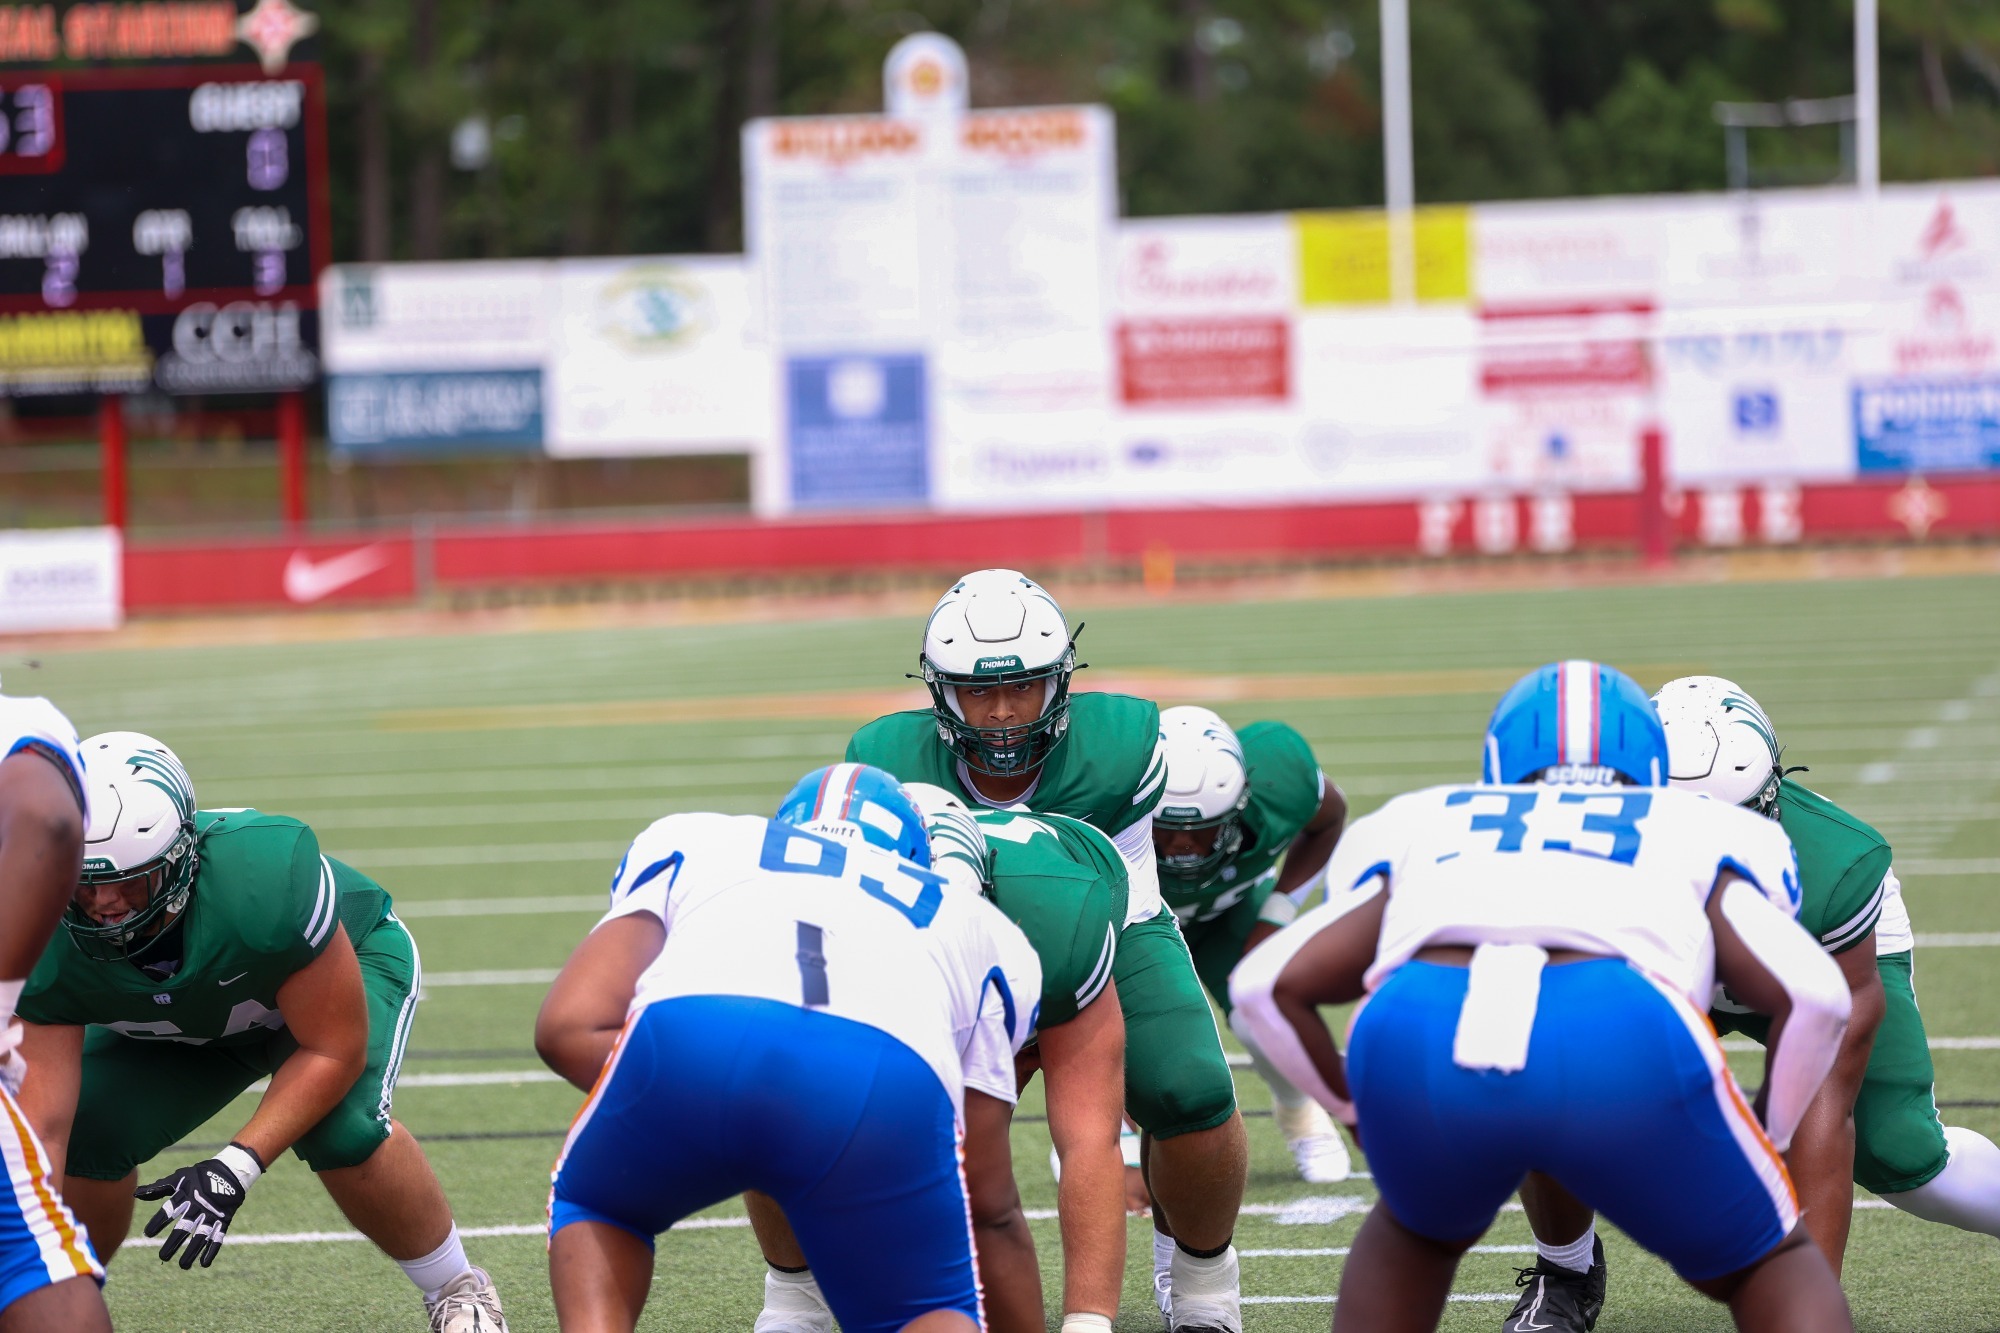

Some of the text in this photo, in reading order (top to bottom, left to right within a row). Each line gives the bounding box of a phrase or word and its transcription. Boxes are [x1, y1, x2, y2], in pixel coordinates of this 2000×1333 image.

[172, 301, 301, 364] CCH
[981, 659, 1016, 669] THOMAS
[1544, 763, 1616, 784] schutt
[1436, 790, 1653, 867] 33
[82, 862, 106, 870] OMAS
[206, 1170, 236, 1196] adidas
